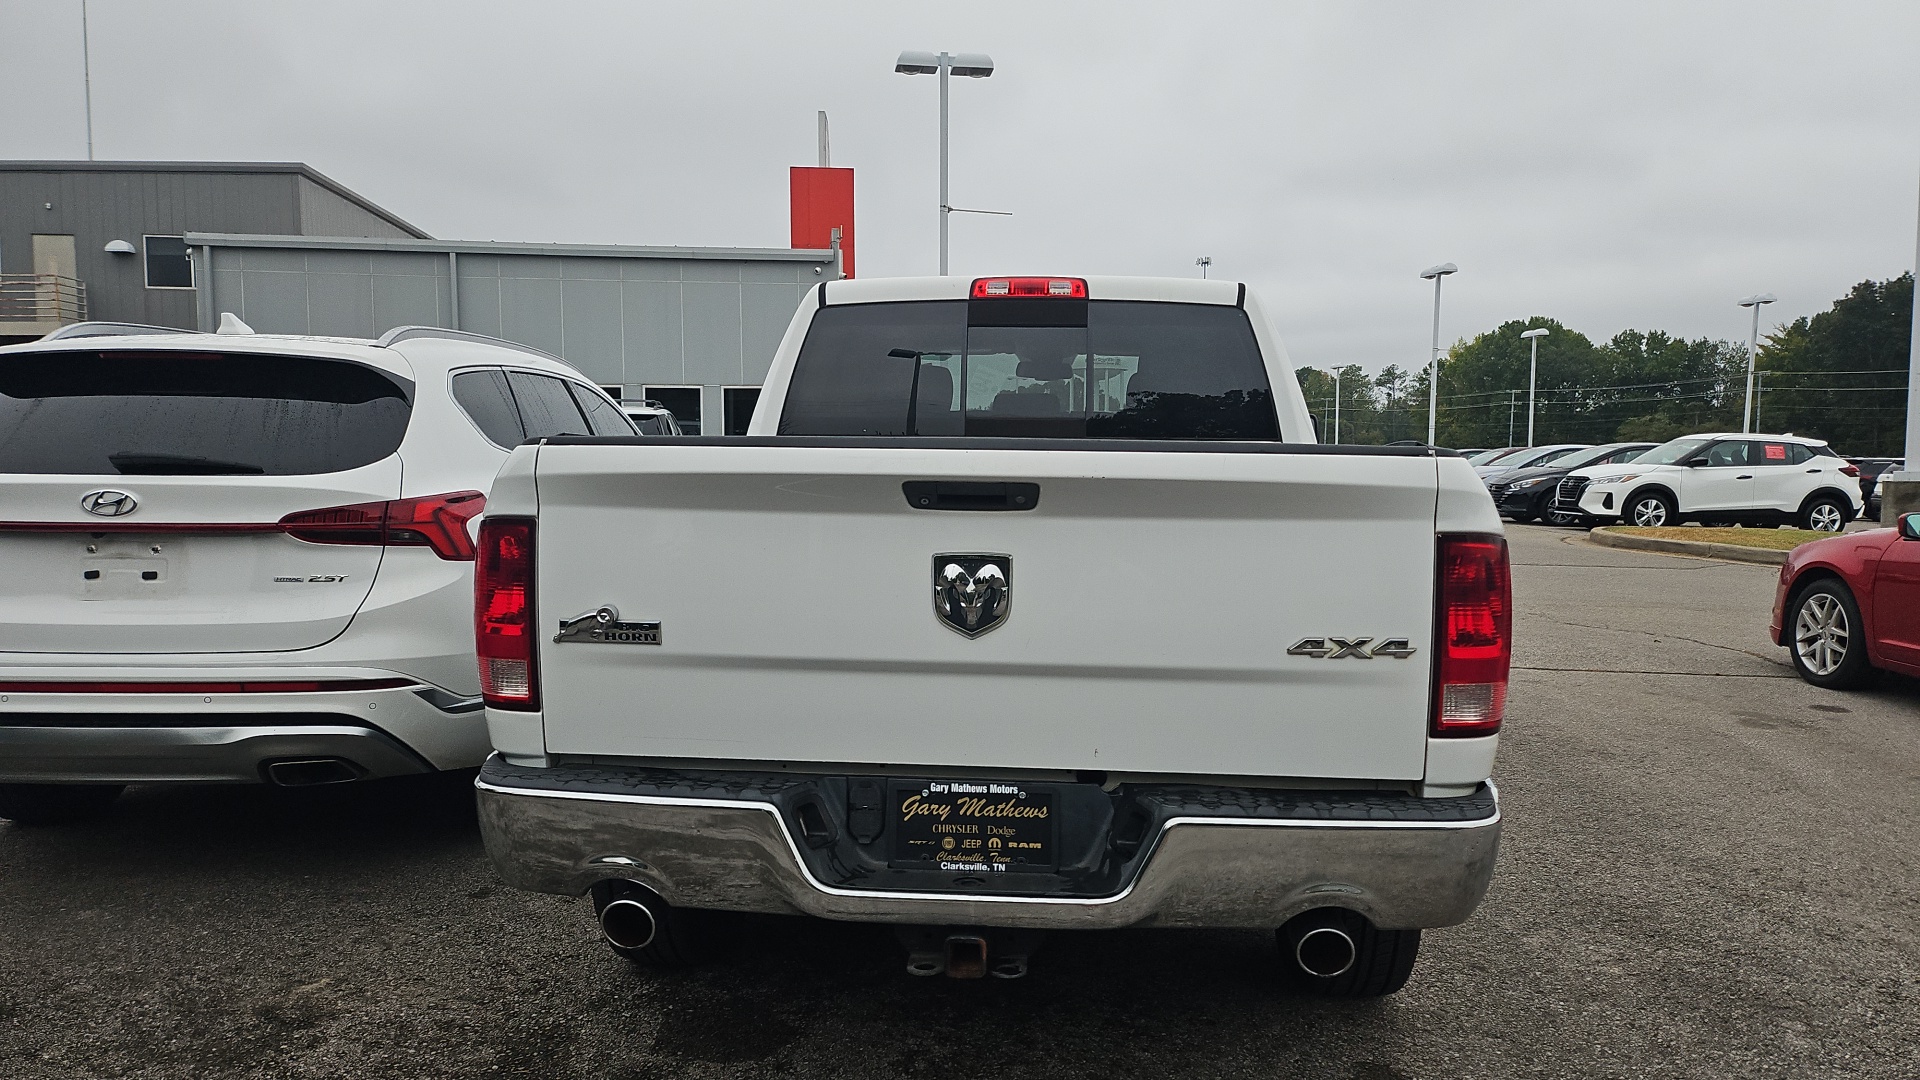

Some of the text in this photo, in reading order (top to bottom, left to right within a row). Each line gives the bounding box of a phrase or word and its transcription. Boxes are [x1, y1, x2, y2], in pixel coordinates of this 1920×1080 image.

[604, 632, 657, 641] HORN
[1286, 637, 1417, 660] 4X4
[930, 782, 1018, 794] Gary Mathews Motors
[902, 794, 1049, 822] Gary Mathews
[932, 824, 979, 834] CHRYSLER
[987, 825, 1016, 837] Dodge
[961, 839, 982, 849] JEEP
[1008, 841, 1042, 849] RAM
[940, 861, 1006, 872] Clarksville, TN
